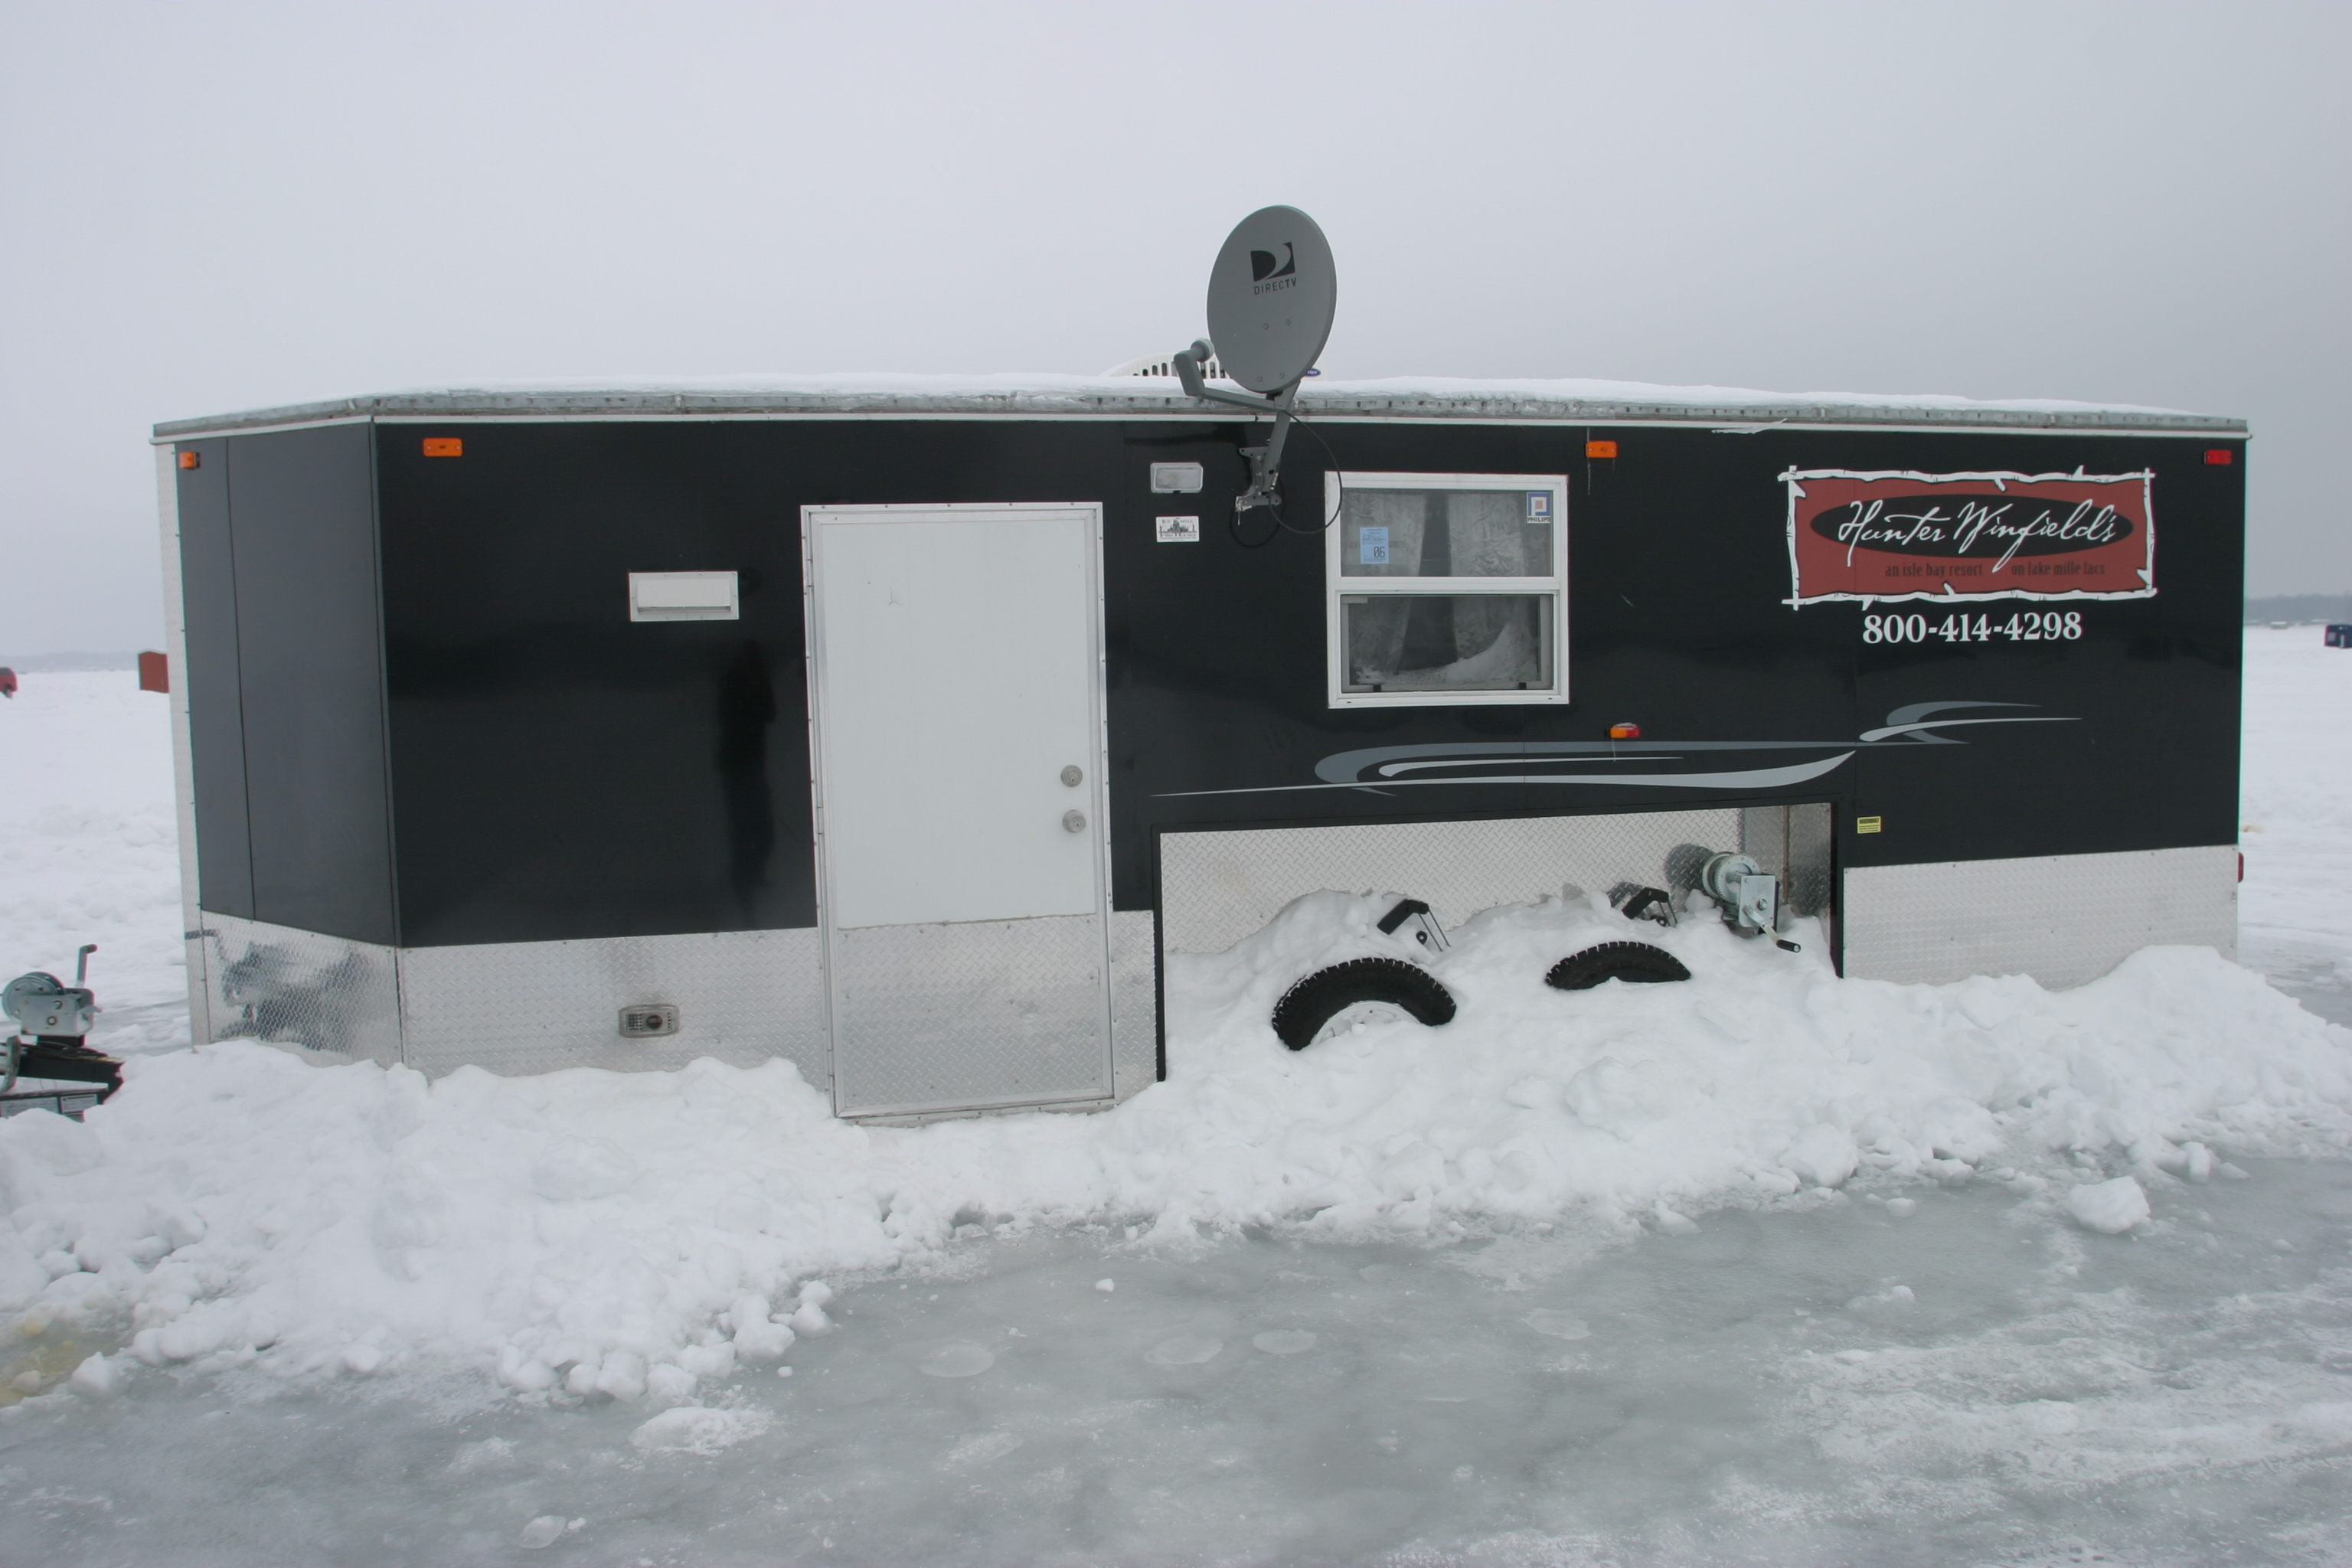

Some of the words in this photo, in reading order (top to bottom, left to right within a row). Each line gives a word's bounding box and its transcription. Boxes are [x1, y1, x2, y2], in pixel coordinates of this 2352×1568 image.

[1253, 277, 1297, 295] DIRECTV
[1838, 499, 1951, 567] Hunter
[1953, 498, 2116, 573] Winfield's
[1374, 546, 1386, 558] 06
[1885, 565, 1900, 577] an
[1903, 563, 1922, 577] isle
[1926, 563, 1945, 578] bay
[1949, 564, 1983, 577] resort
[2011, 564, 2025, 576] on
[2027, 561, 2051, 576] lake
[2053, 561, 2081, 576] mille
[2083, 561, 2105, 575] lacs
[1862, 611, 2082, 644] 800-414-4298
